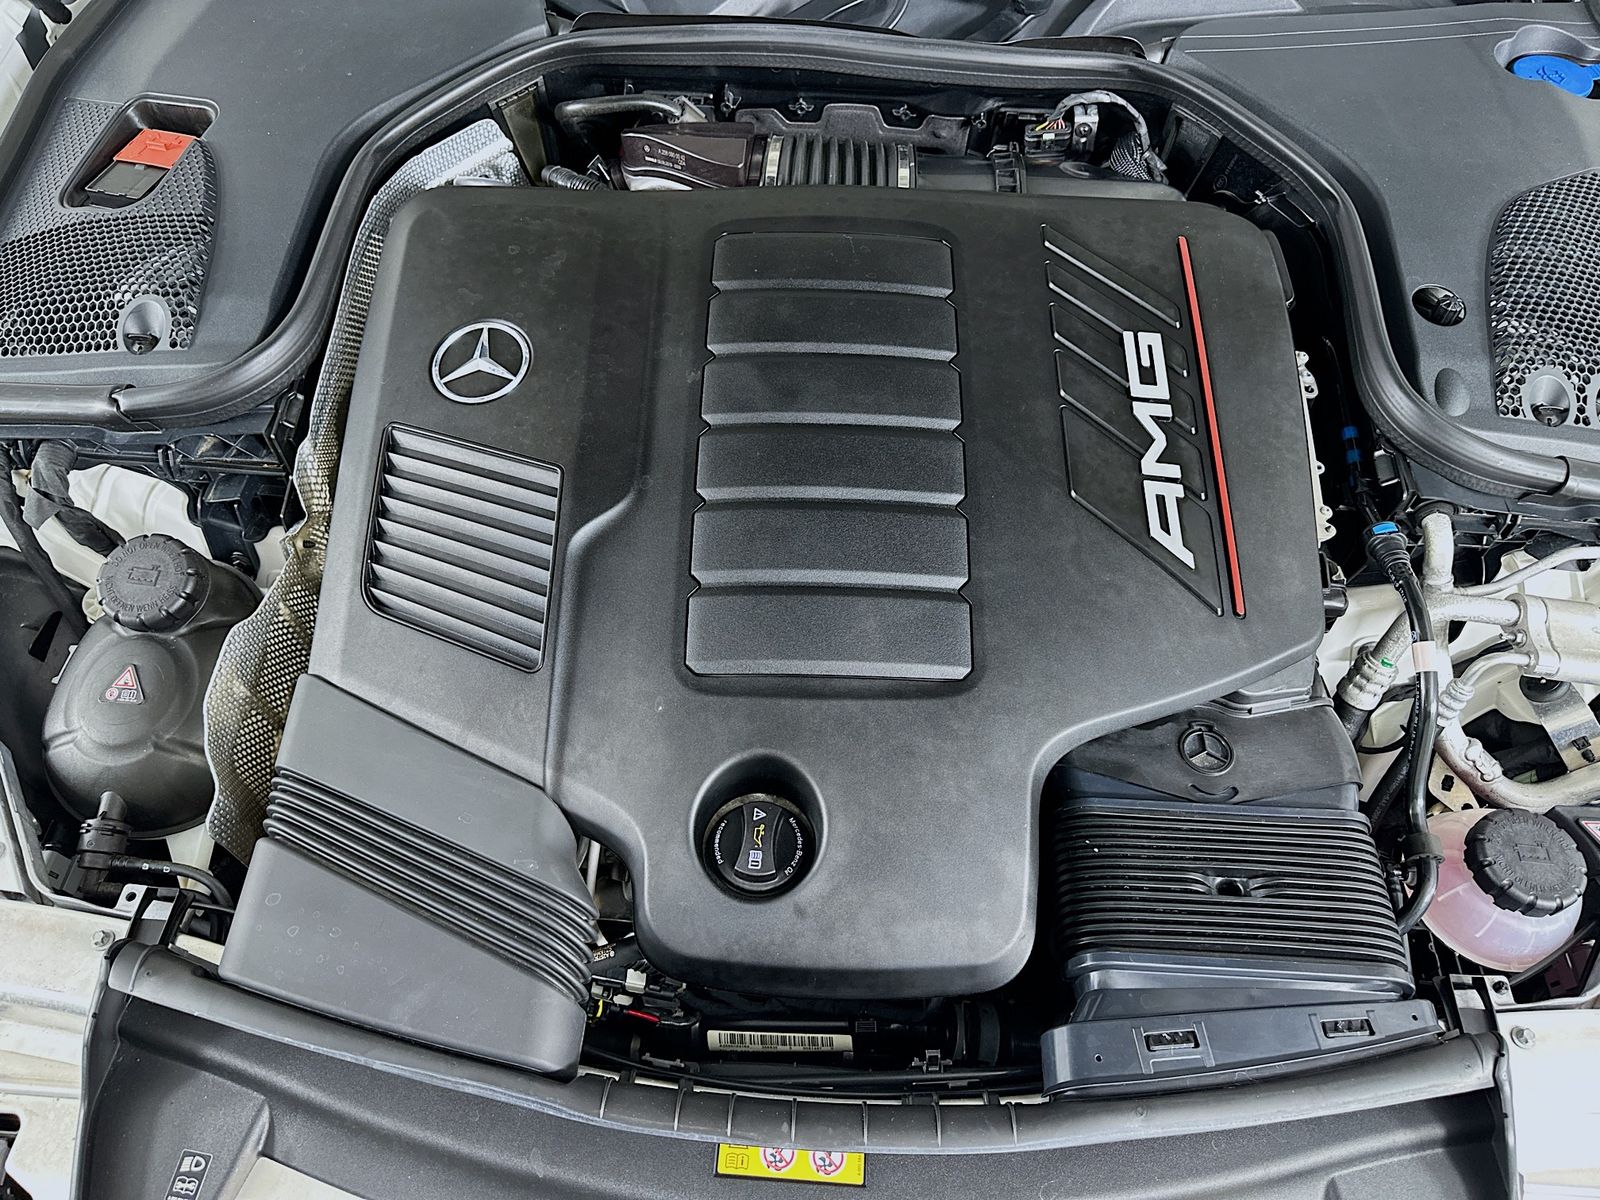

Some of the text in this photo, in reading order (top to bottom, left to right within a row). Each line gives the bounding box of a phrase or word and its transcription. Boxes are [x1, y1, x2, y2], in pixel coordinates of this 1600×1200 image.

[1122, 330, 1195, 570] AMG
[139, 541, 161, 550] OPEN
[135, 600, 159, 613] WENN
[160, 584, 178, 604] HEISS
